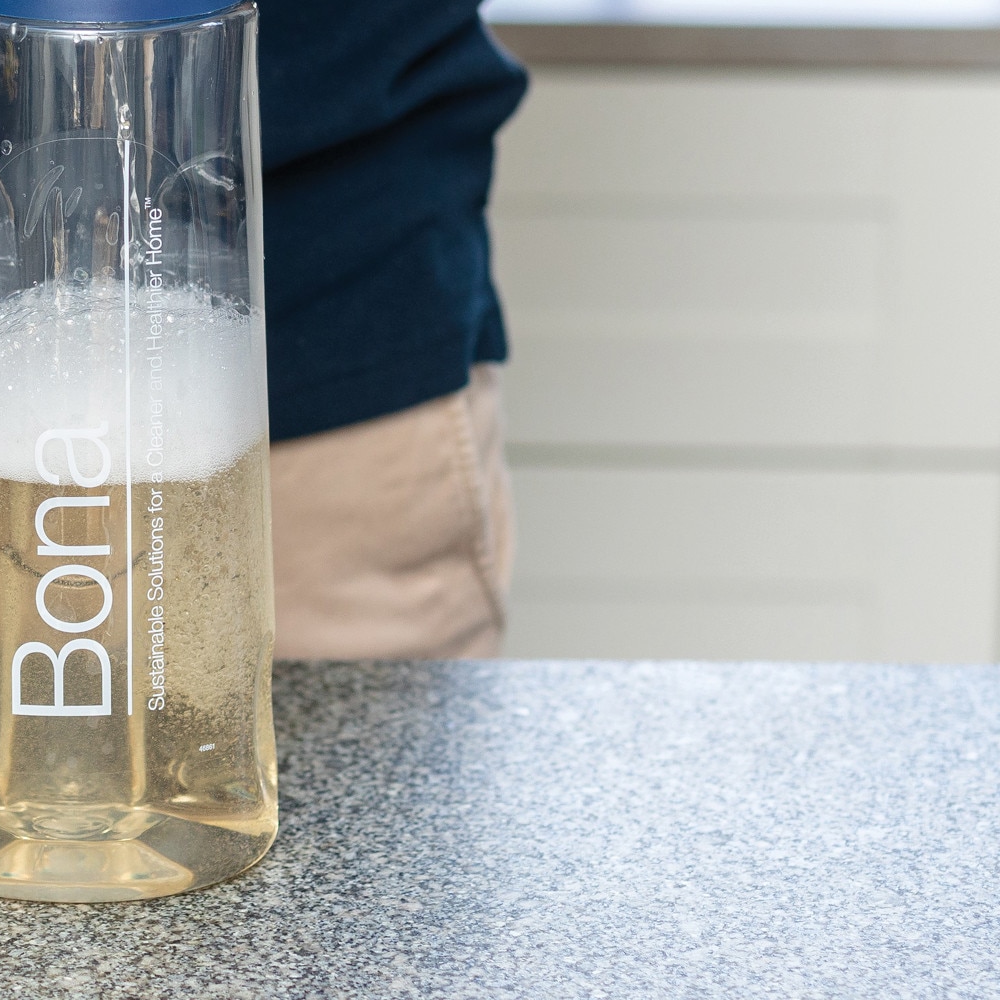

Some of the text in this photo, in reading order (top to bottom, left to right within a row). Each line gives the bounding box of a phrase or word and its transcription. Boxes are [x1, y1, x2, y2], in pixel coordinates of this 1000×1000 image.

[146, 267, 163, 351] Healthier
[146, 355, 163, 391] and
[146, 396, 164, 467] Cleaner
[147, 487, 165, 513] for
[151, 471, 164, 483] a
[11, 419, 113, 717] Bona
[147, 517, 165, 601] Solutions
[147, 605, 165, 711] Sustainable
